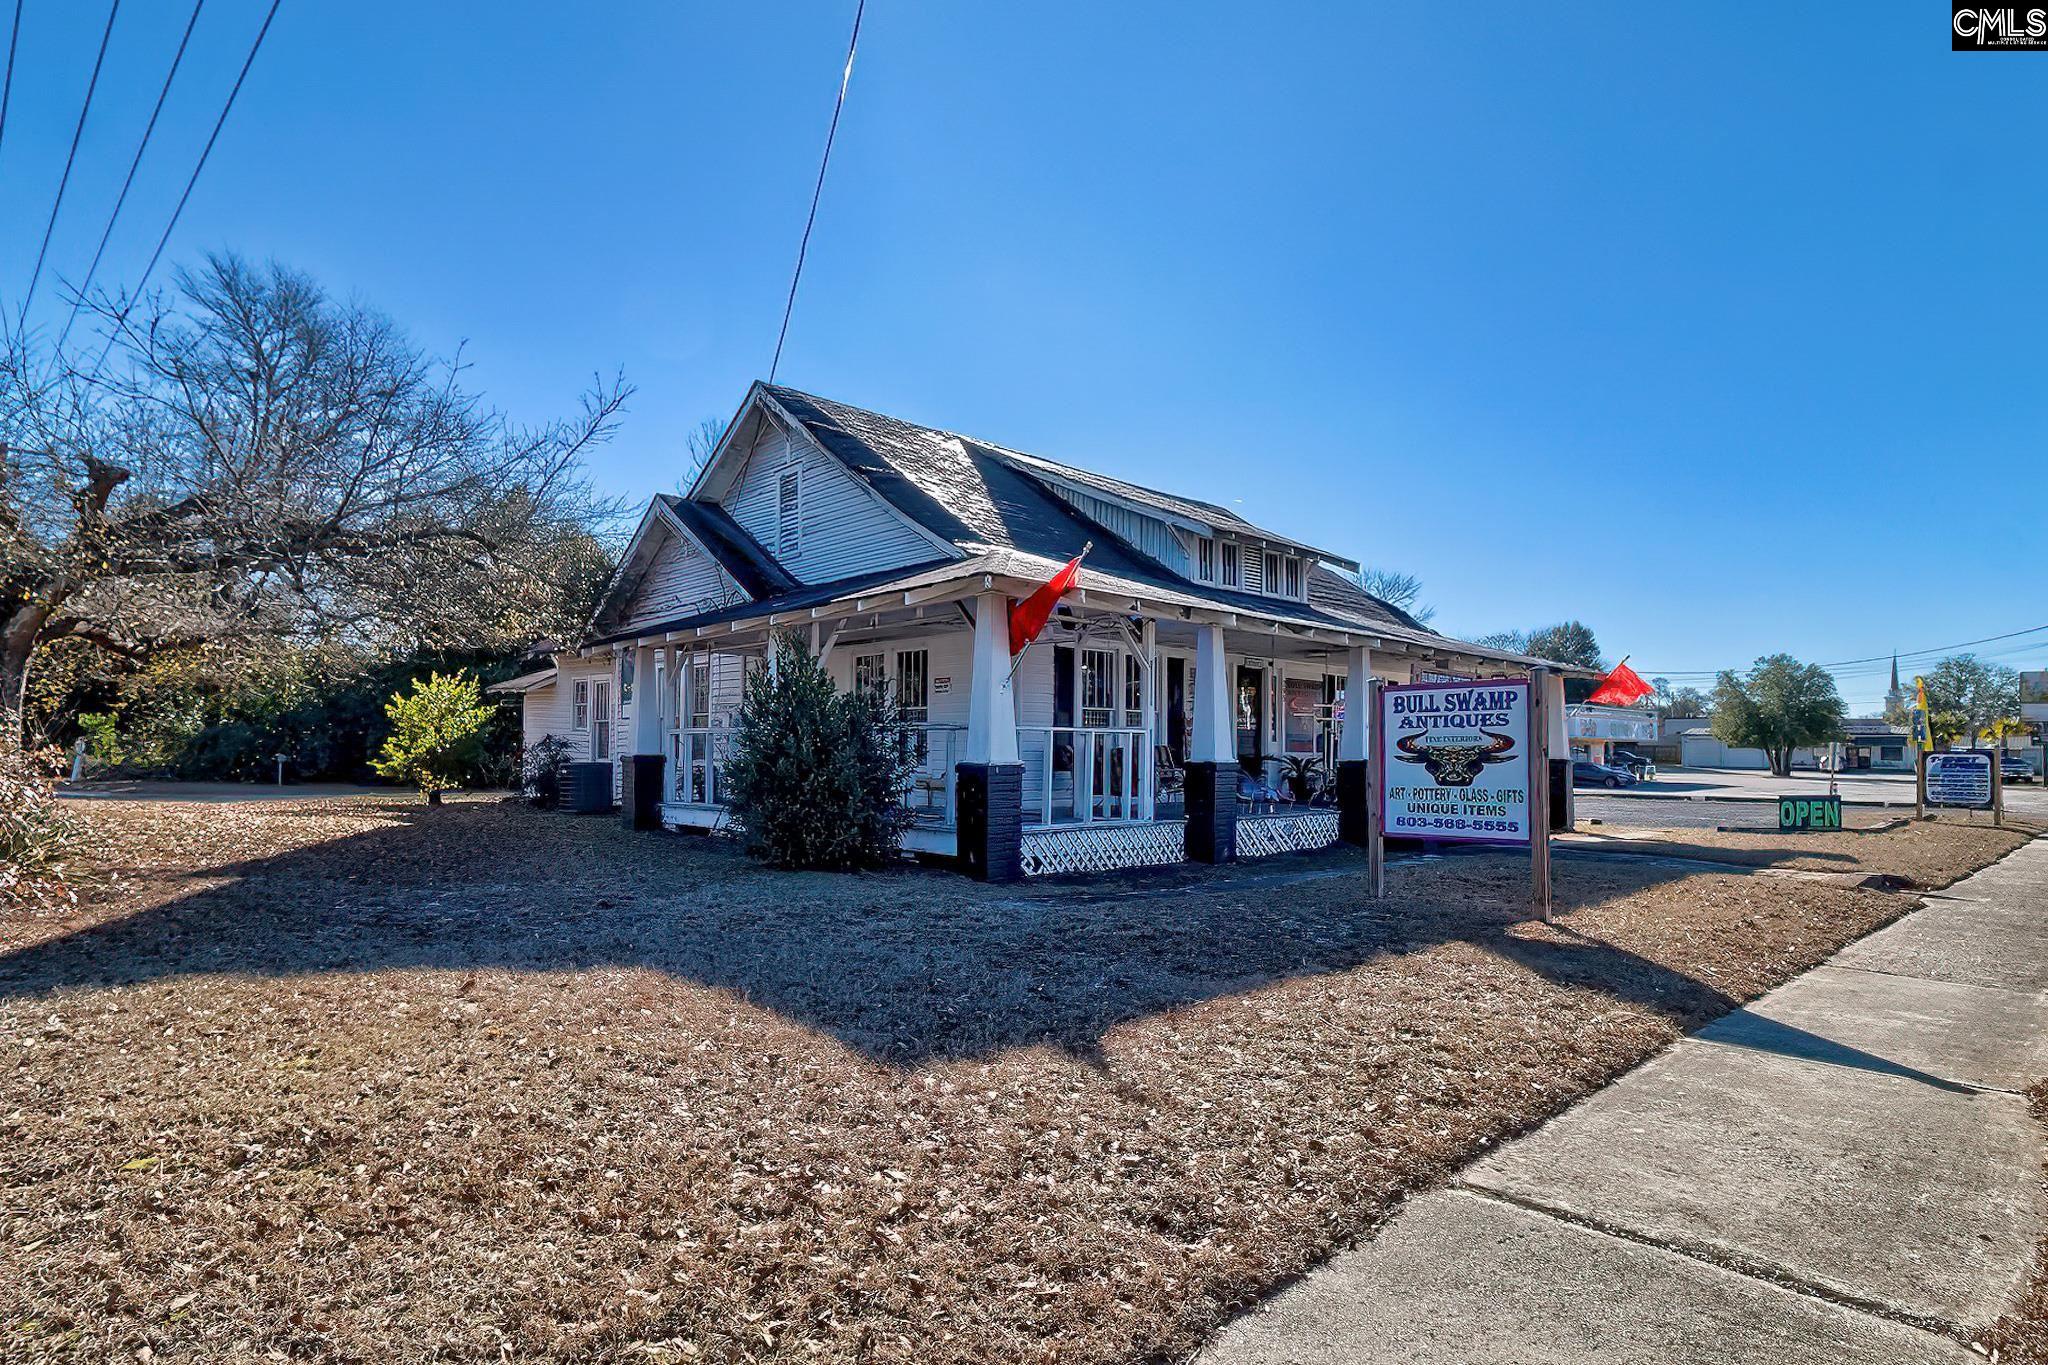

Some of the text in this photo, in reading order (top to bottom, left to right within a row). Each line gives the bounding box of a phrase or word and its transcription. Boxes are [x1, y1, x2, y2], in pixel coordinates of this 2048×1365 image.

[1393, 689, 1518, 714] BULL SWAMP
[1398, 713, 1510, 729] ANTIQUES
[1389, 787, 1524, 804] ART POTTERY GLASS GIFTS
[1407, 802, 1507, 816] UNIQUE ITEMS
[1780, 801, 1841, 828] OPEN
